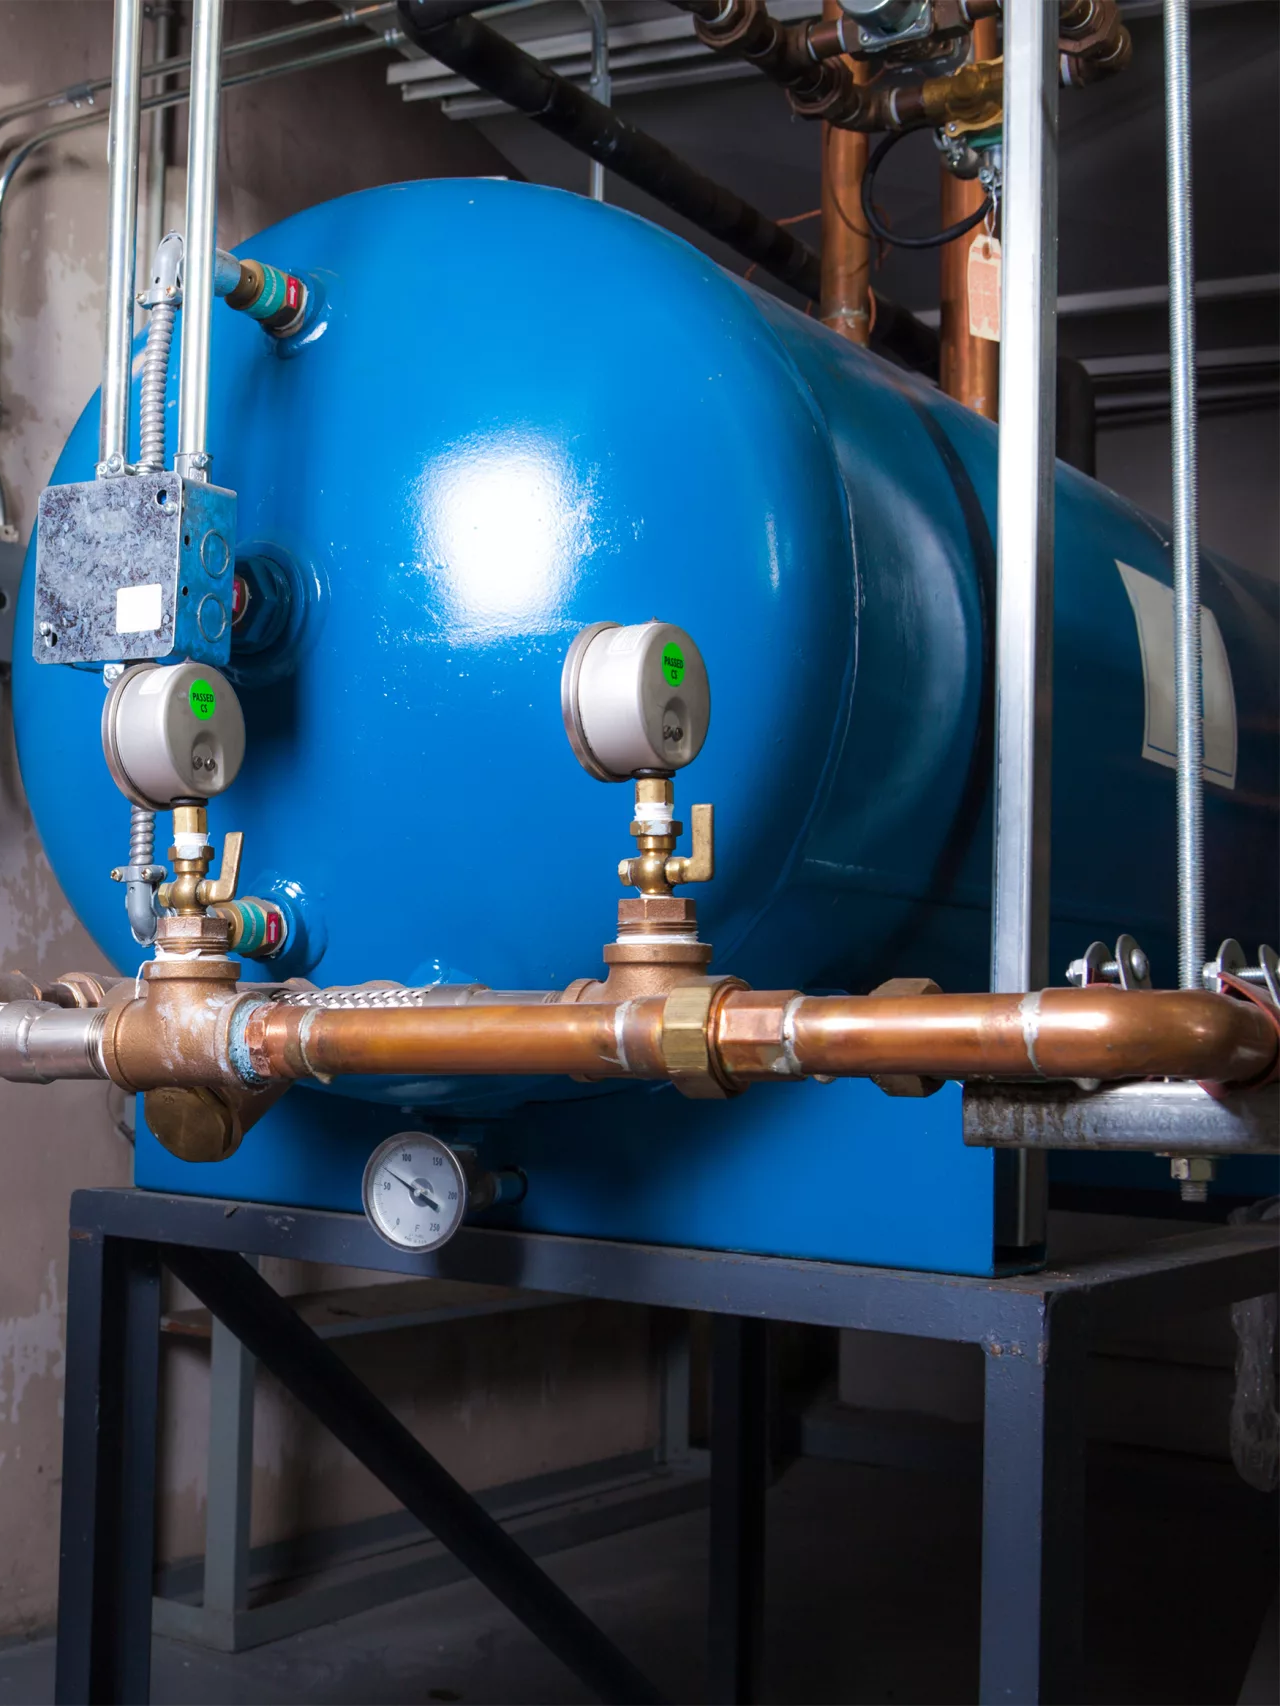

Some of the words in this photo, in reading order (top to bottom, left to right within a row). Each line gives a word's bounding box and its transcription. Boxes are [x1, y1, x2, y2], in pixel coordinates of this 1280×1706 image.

[664, 656, 684, 669] PASSED
[192, 692, 214, 703] PASSED
[200, 704, 208, 713] CS
[402, 1153, 412, 1162] 100
[432, 1156, 443, 1166] 150
[383, 1181, 391, 1190] 50
[448, 1190, 457, 1200] 200
[396, 1217, 400, 1225] 0
[415, 1224, 420, 1232] F
[429, 1222, 440, 1232] 250
